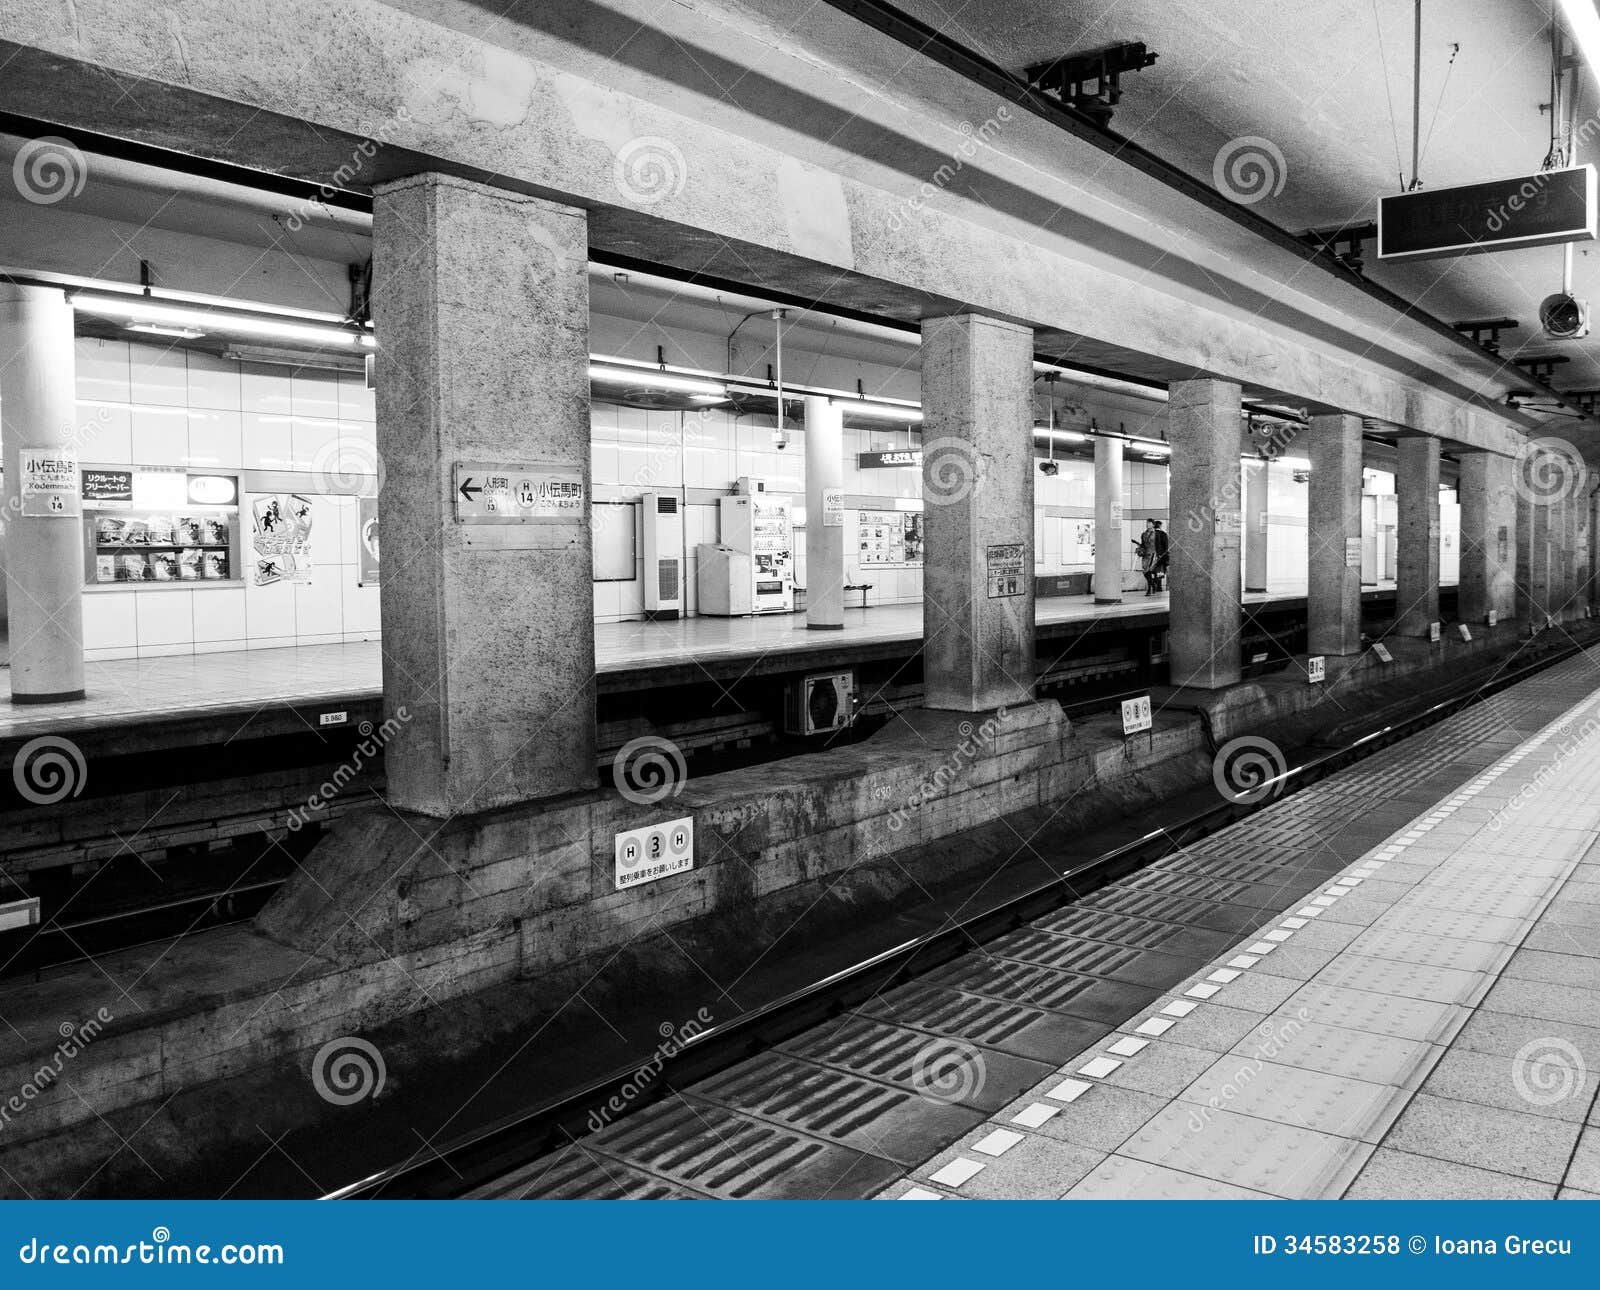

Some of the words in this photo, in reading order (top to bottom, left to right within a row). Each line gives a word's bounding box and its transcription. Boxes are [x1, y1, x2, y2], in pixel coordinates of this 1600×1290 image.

[88, 474, 126, 483] リクルートの
[483, 477, 509, 489] 人形町
[523, 482, 529, 491] H
[539, 482, 582, 499] 小伝馬町
[521, 492, 533, 503] 14
[52, 502, 63, 510] 14
[627, 846, 635, 858] H
[652, 836, 660, 852] 3
[676, 834, 683, 845] H
